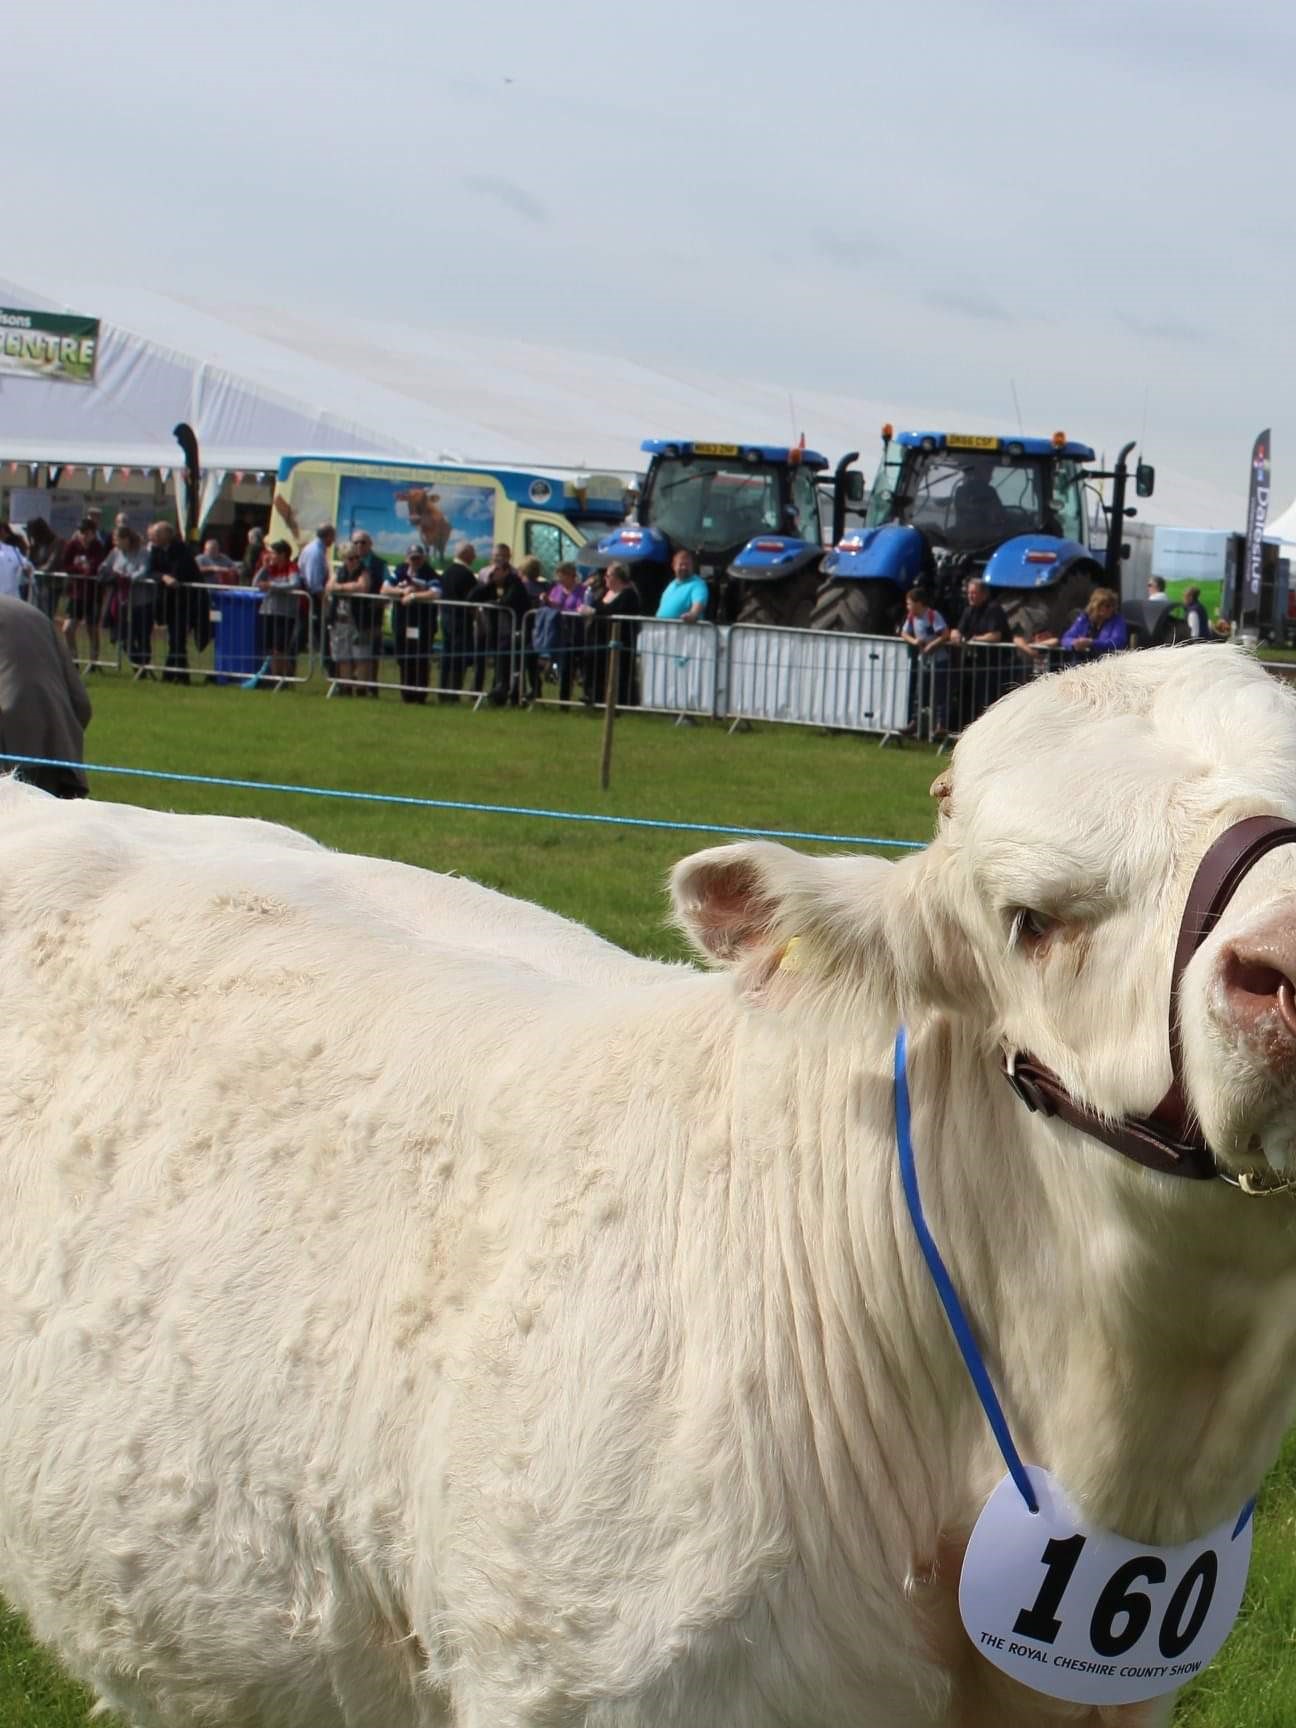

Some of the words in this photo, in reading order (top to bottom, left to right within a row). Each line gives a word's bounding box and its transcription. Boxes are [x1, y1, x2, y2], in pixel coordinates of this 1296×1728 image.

[1012, 1533, 1218, 1659] 160
[980, 1631, 1005, 1650] THE
[1008, 1642, 1048, 1663] ROYAL
[1054, 1656, 1117, 1676] CHESHIRE
[1120, 1666, 1168, 1677] COUNTY
[1169, 1661, 1202, 1676] SHOW
